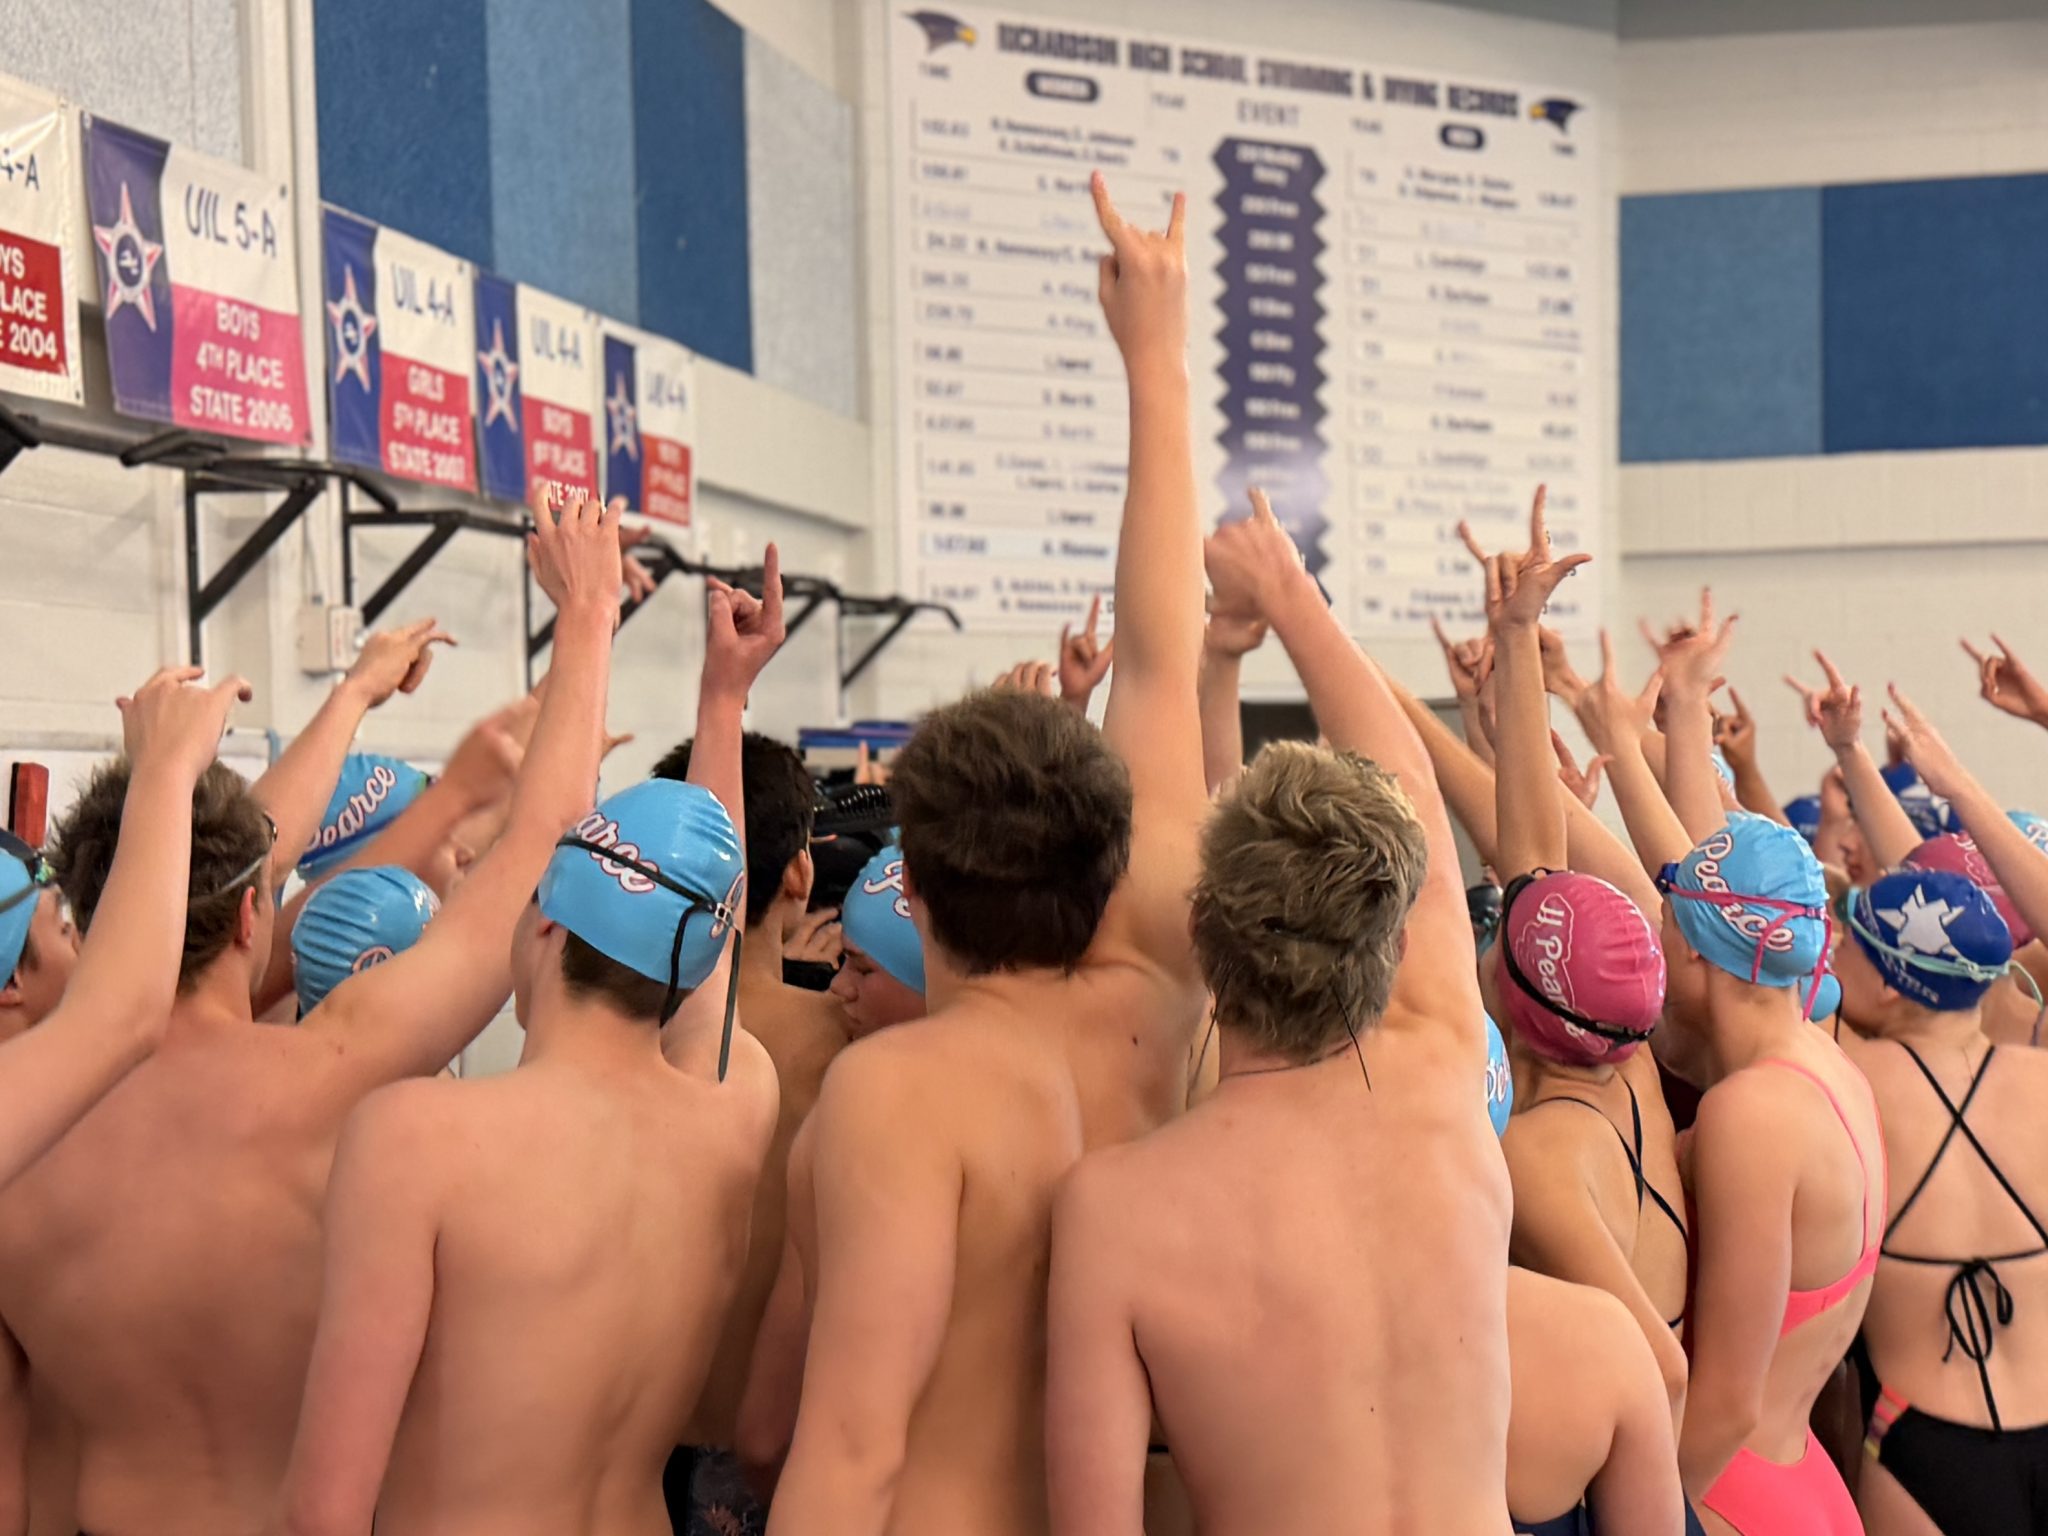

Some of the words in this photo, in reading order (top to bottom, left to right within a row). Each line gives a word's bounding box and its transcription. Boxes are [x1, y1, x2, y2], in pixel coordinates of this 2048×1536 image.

[184, 182, 229, 245] UIL
[234, 201, 278, 259] 5-A
[0, 243, 25, 280] YS
[390, 262, 424, 316] UIL
[9, 321, 58, 362] 2004
[216, 300, 261, 342] BOYS
[226, 348, 286, 391] PLACE
[190, 383, 244, 426] STATE
[247, 399, 295, 433] 2006
[387, 440, 433, 478] STATE
